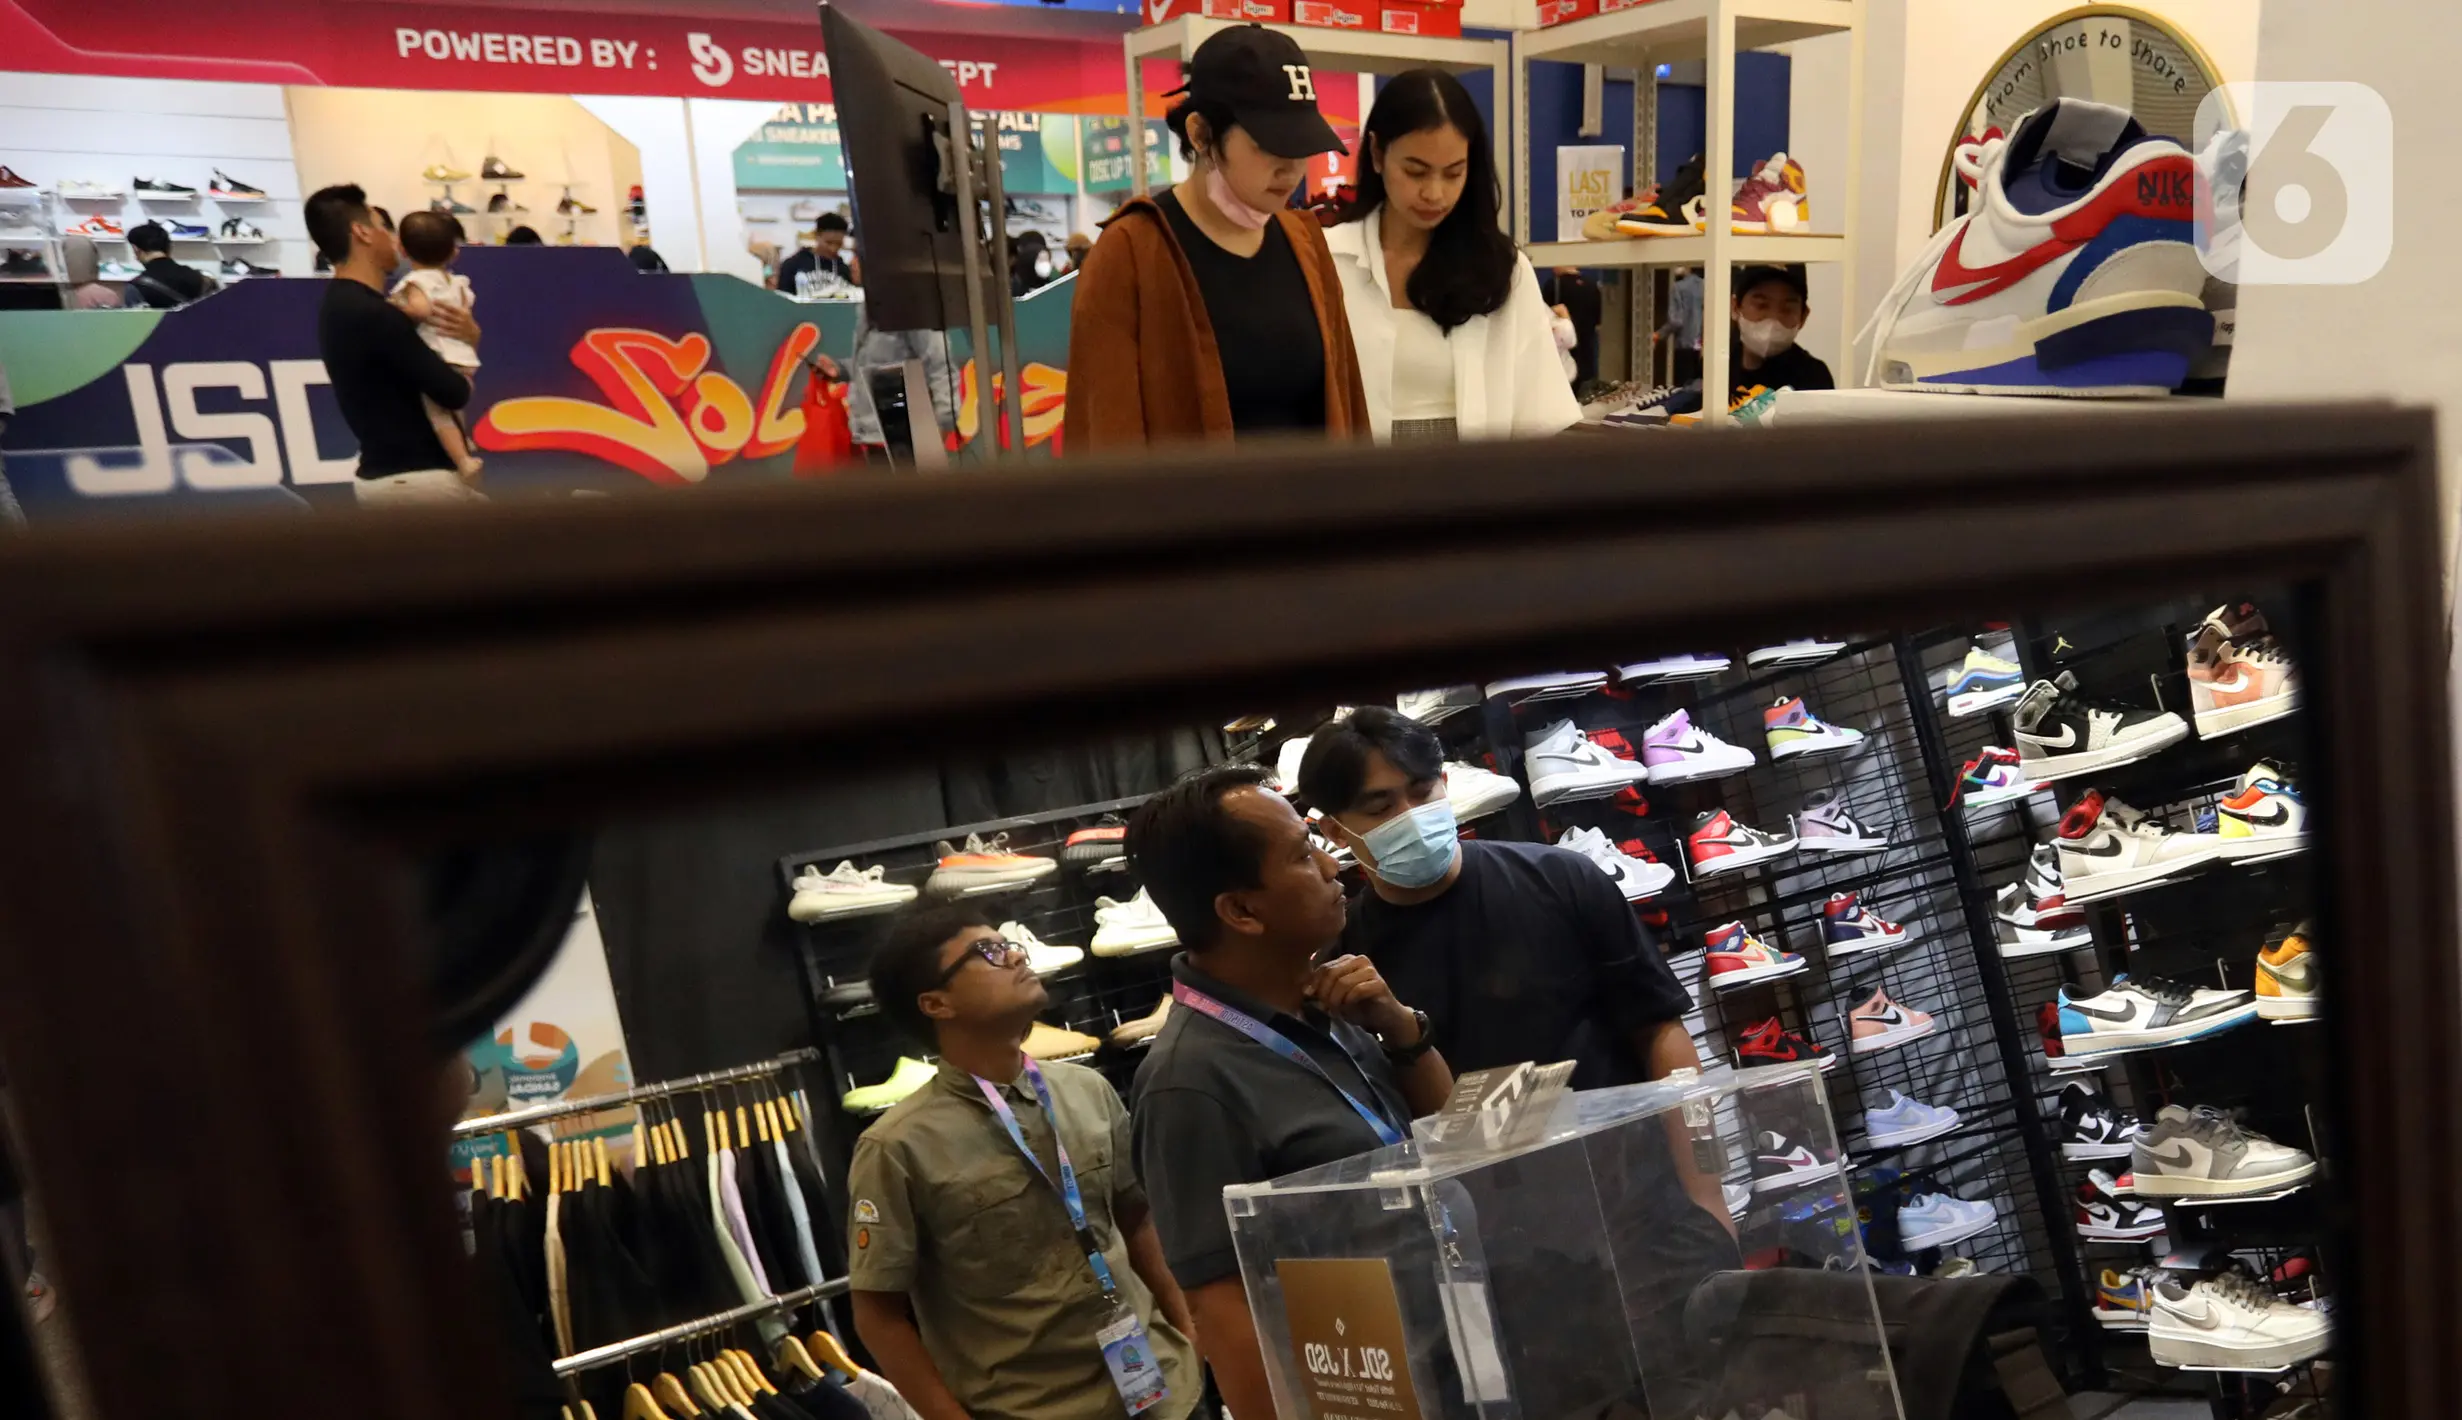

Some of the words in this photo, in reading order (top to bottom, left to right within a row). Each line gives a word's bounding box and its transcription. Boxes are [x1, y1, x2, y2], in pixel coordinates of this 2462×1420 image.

[396, 28, 583, 66] POWERED
[590, 38, 638, 69] BY
[2100, 28, 2121, 49] to
[742, 46, 830, 79] SNEA
[1282, 64, 1316, 100] H
[1569, 168, 1611, 194] LAST
[1571, 208, 1585, 218] TO
